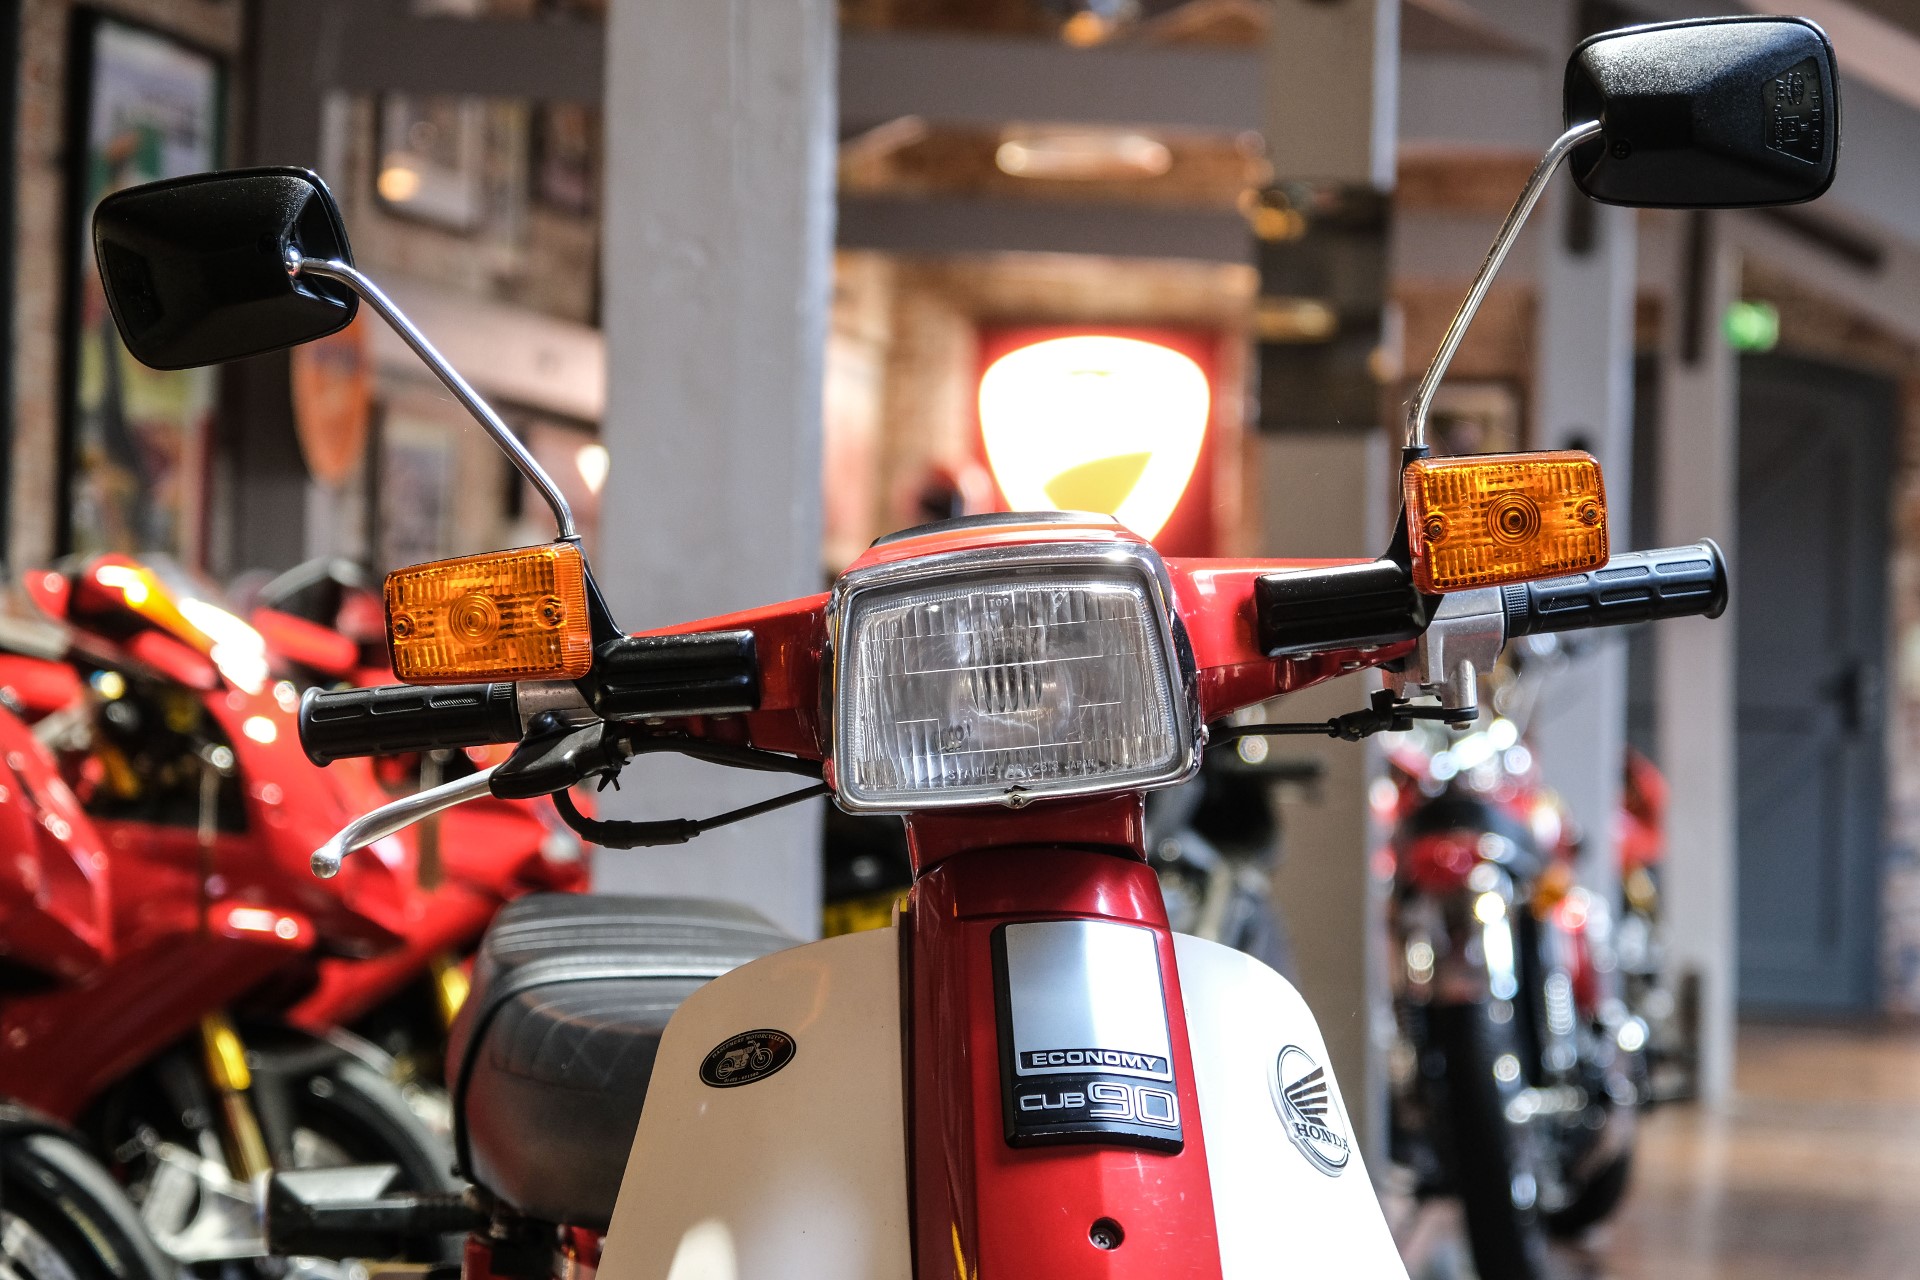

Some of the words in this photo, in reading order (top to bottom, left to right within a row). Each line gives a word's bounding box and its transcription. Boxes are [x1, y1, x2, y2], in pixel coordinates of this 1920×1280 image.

[988, 597, 1009, 607] TOP
[1064, 758, 1096, 771] JAPAN
[745, 1033, 785, 1043] MOTORCYCLES
[1032, 1051, 1158, 1071] ECONOMY
[1019, 1092, 1086, 1112] CUB
[1086, 1081, 1180, 1130] 90
[1293, 1121, 1352, 1154] HONDA
